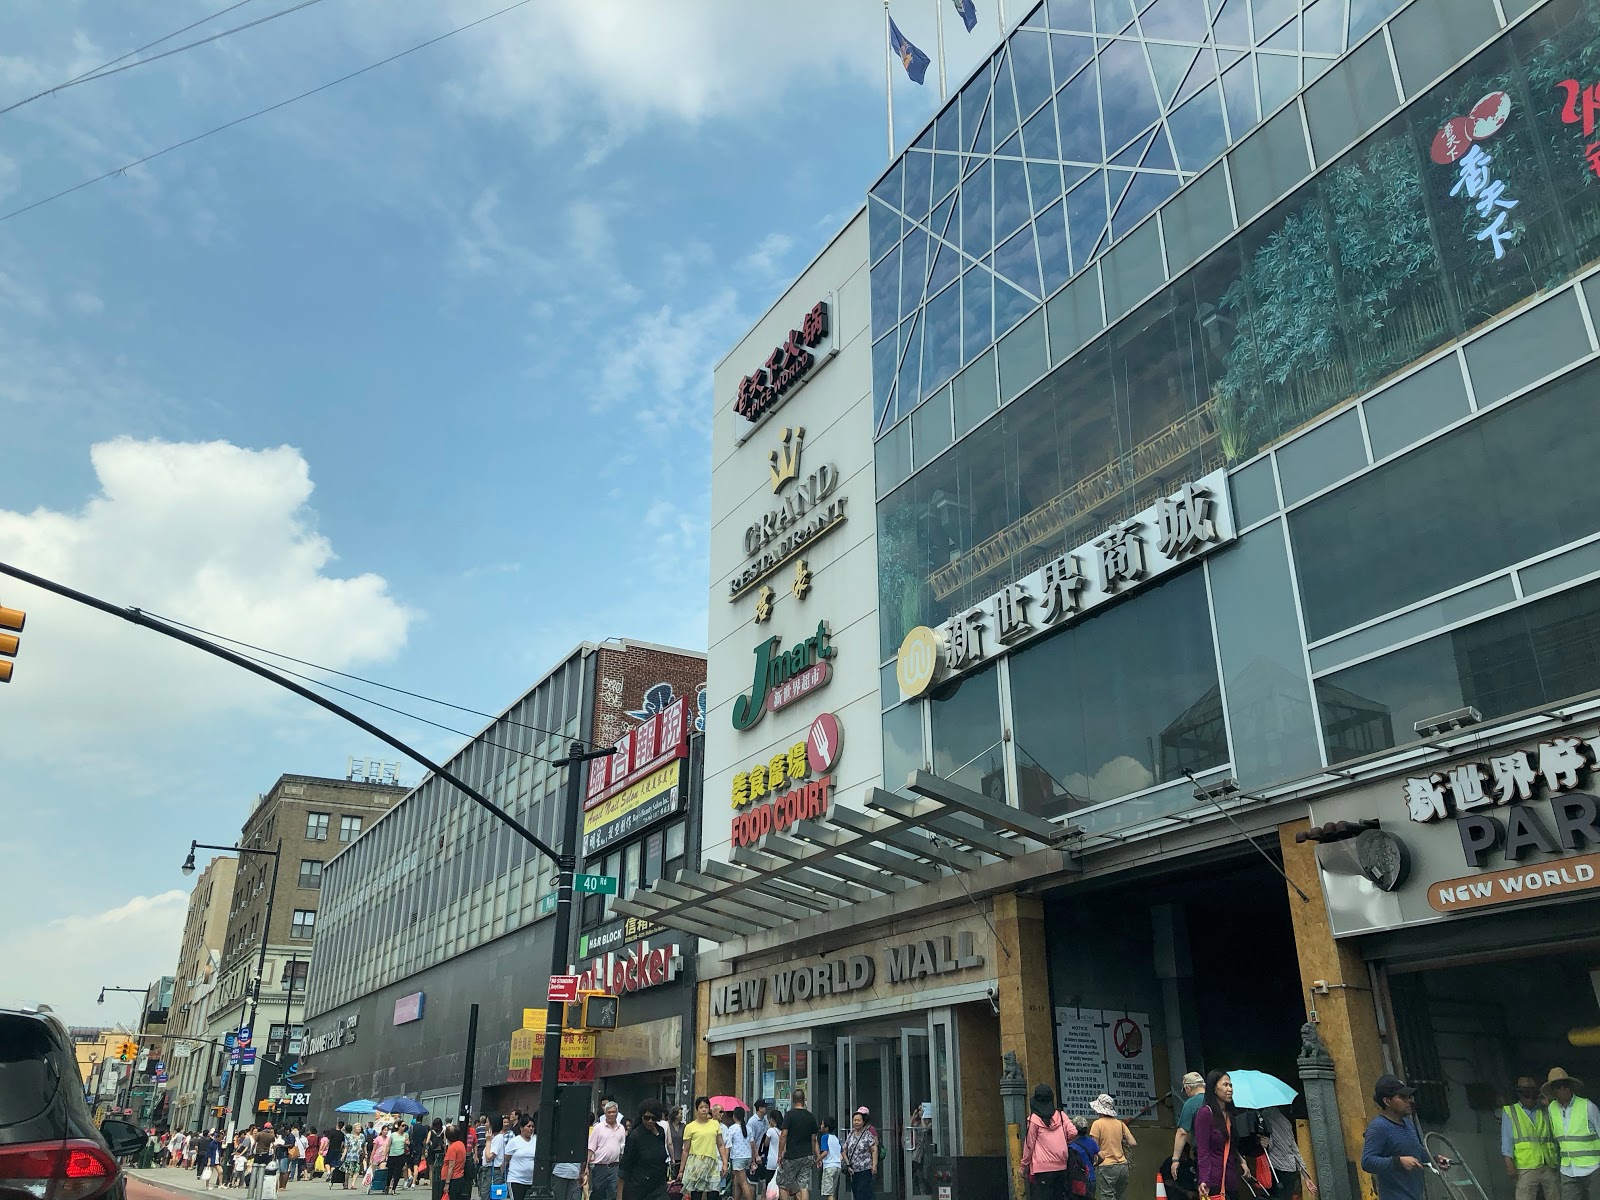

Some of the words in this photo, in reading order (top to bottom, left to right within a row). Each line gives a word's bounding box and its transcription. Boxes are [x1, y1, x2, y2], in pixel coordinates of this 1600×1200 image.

[746, 388, 772, 419] SPICE
[774, 353, 808, 393] WORLD
[742, 462, 838, 555] GRAND
[728, 496, 848, 597] RESTAURANT
[945, 482, 1213, 669] 新世界商城
[773, 668, 820, 707] 新世界超市
[731, 741, 807, 809] 美食廣場
[731, 803, 771, 848] FOOD
[774, 776, 831, 832] COURT
[584, 877, 597, 890] 40
[600, 878, 607, 886] Rd
[1439, 880, 1493, 905] NEW
[1499, 864, 1594, 894] WORLD
[589, 938, 601, 950] H&R
[602, 929, 622, 946] BLOCK
[603, 941, 677, 995] Locker
[711, 977, 766, 1016] NEW
[770, 955, 875, 1004] WORLD
[885, 931, 983, 984] MALL
